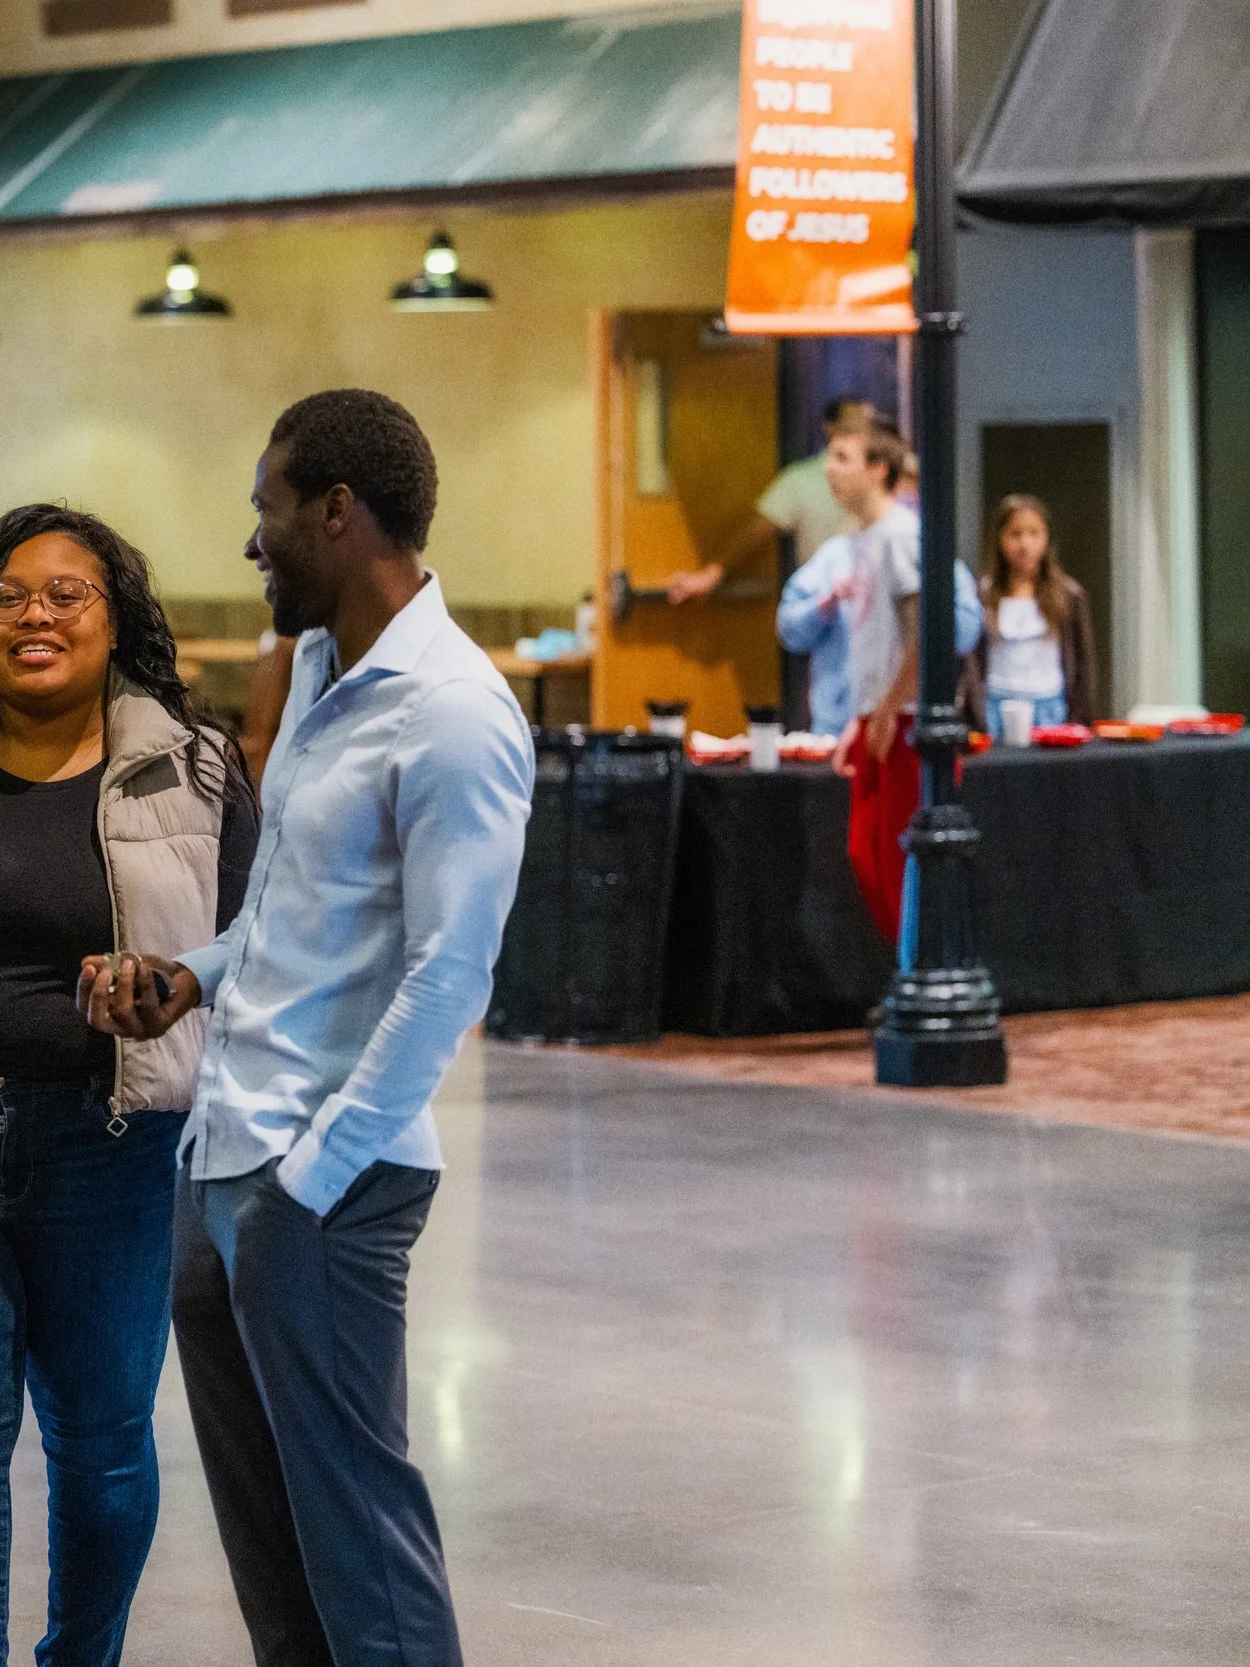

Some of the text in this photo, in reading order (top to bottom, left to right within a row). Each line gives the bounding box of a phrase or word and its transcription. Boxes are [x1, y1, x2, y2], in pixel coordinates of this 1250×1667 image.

[755, 36, 853, 71] PEOPLE
[753, 79, 832, 113] TO BE
[750, 123, 895, 160] AUTHENTIC
[748, 166, 907, 203] FOLLOWERS
[746, 210, 870, 244] OF JESUS
